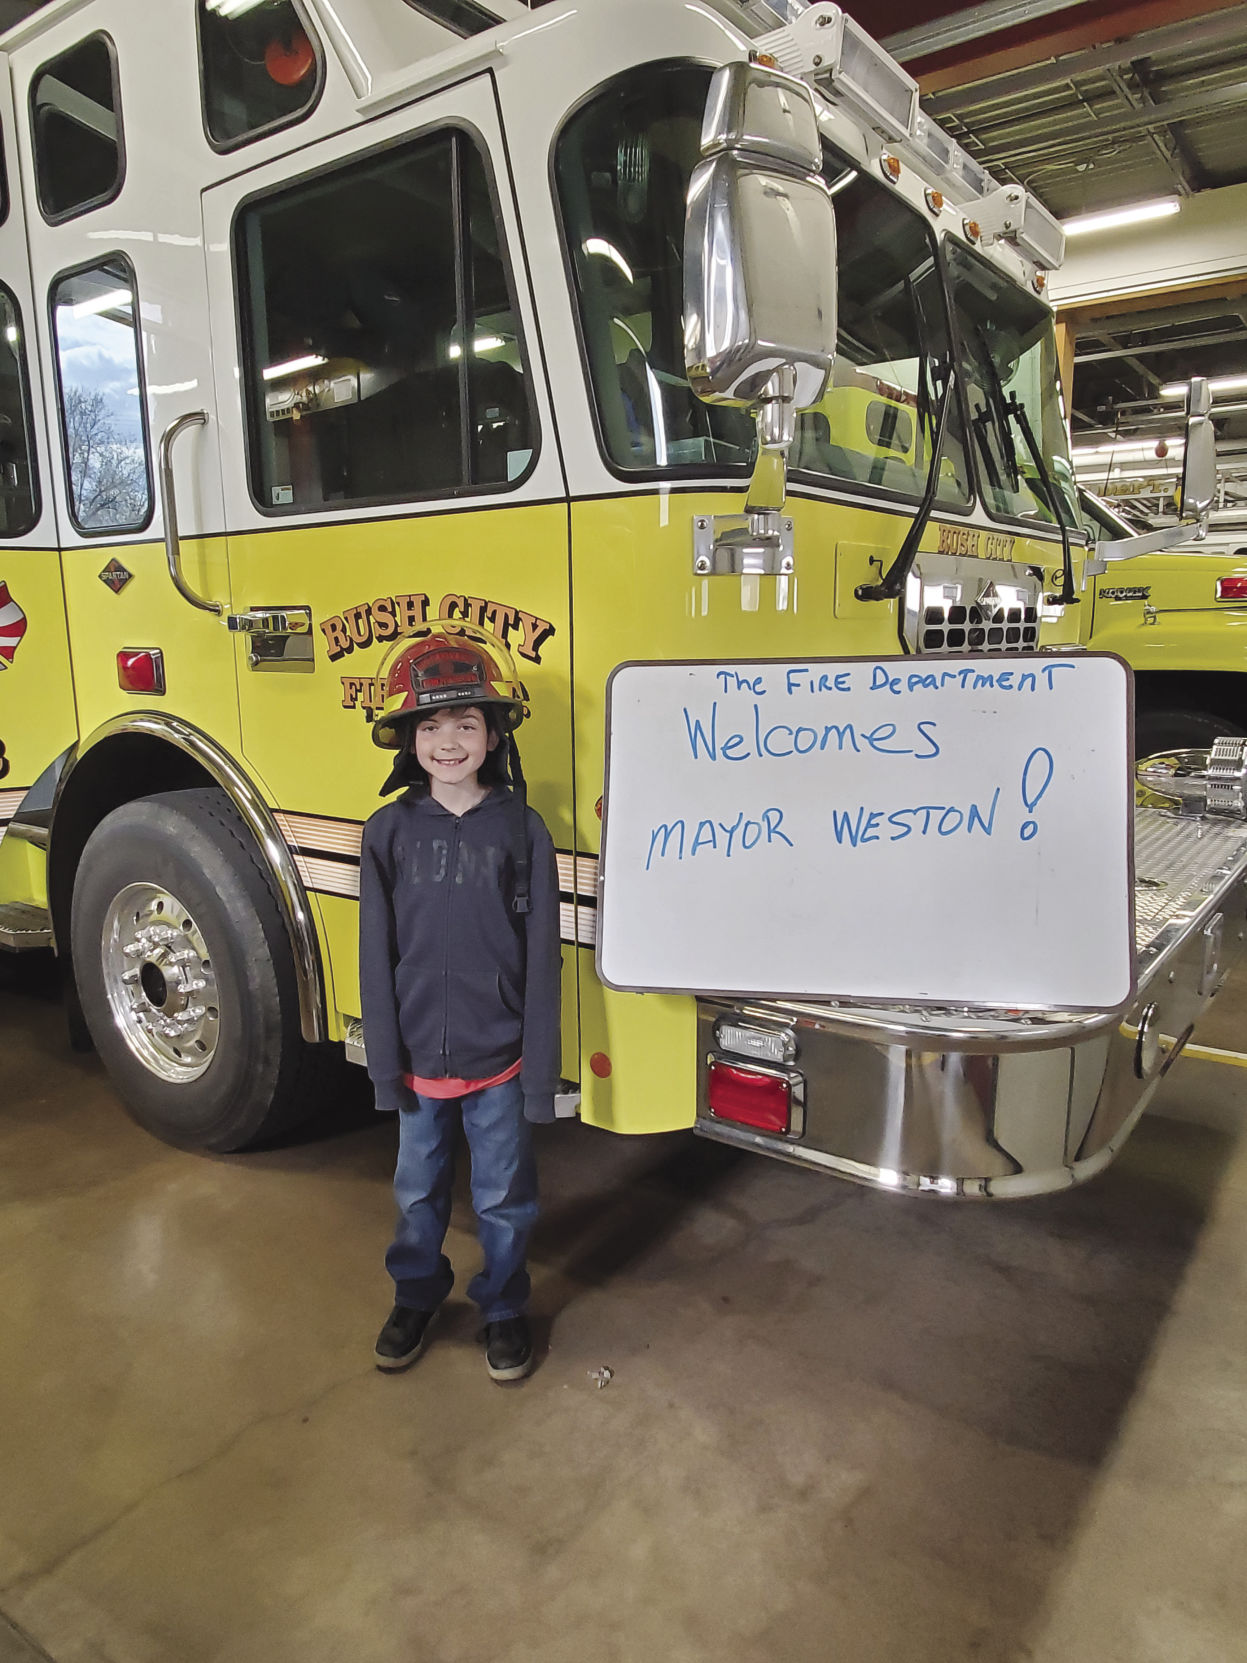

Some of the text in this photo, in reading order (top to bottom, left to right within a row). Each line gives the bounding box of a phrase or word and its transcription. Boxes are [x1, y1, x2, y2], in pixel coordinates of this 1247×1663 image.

[938, 524, 1016, 562] RUSH CITY
[320, 593, 556, 665] RUSH CITY
[716, 670, 767, 696] The
[786, 668, 852, 695] FIRE
[683, 701, 941, 761] Welcomes
[645, 807, 794, 870] MAYOR
